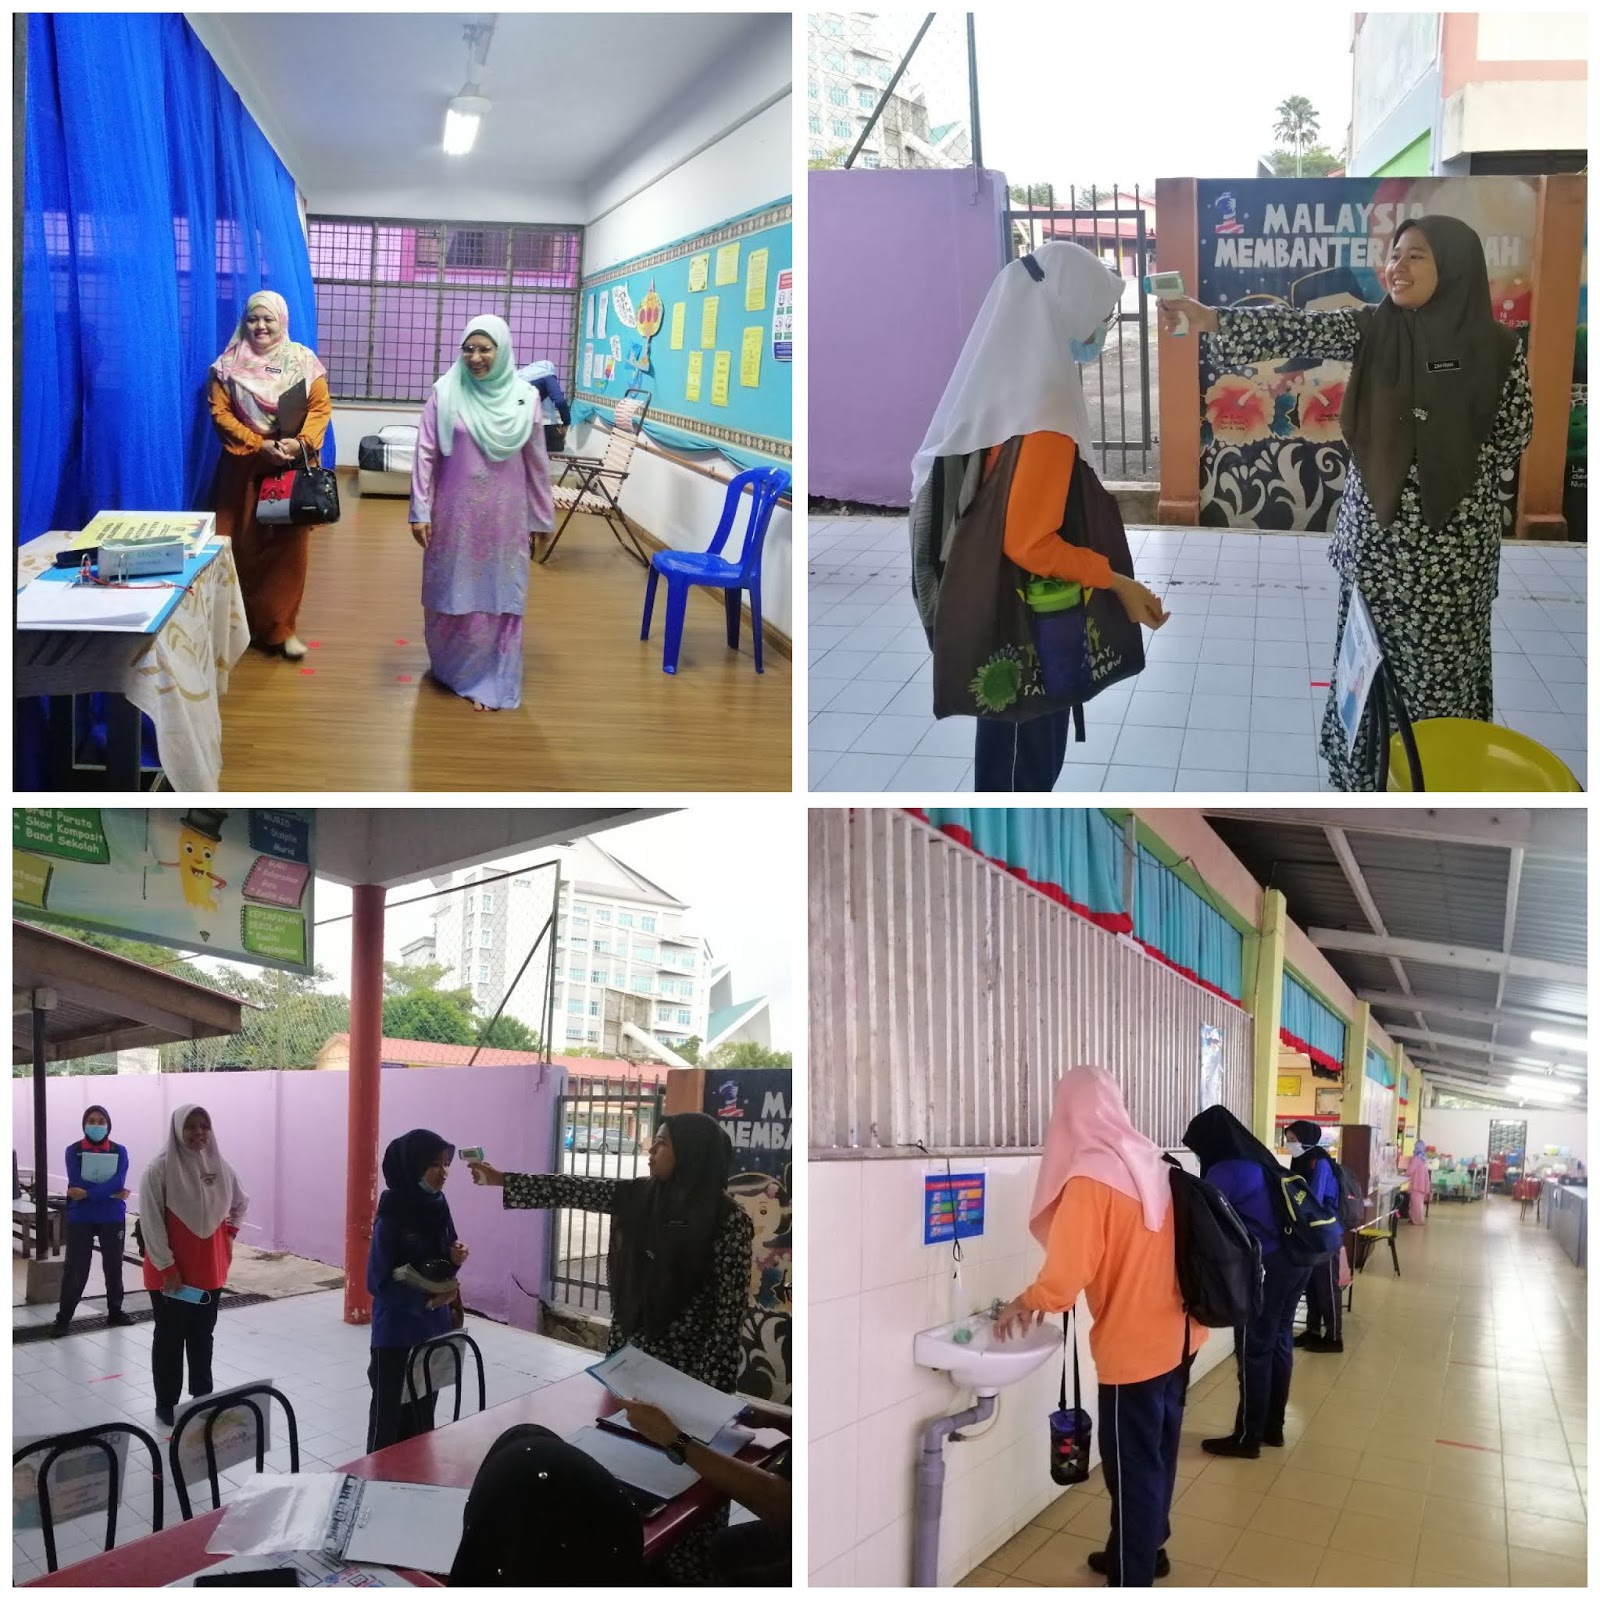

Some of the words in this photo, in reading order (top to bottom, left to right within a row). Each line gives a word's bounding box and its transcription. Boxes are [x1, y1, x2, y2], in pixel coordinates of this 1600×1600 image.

[1483, 236, 1520, 267] AH
[1088, 645, 1115, 669] DAY,
[1091, 654, 1122, 681] RROW
[25, 816, 52, 830] Skor
[56, 823, 104, 843] Komposit
[57, 811, 93, 829] Purata
[26, 827, 54, 842] Band
[57, 836, 100, 854] Sekolah
